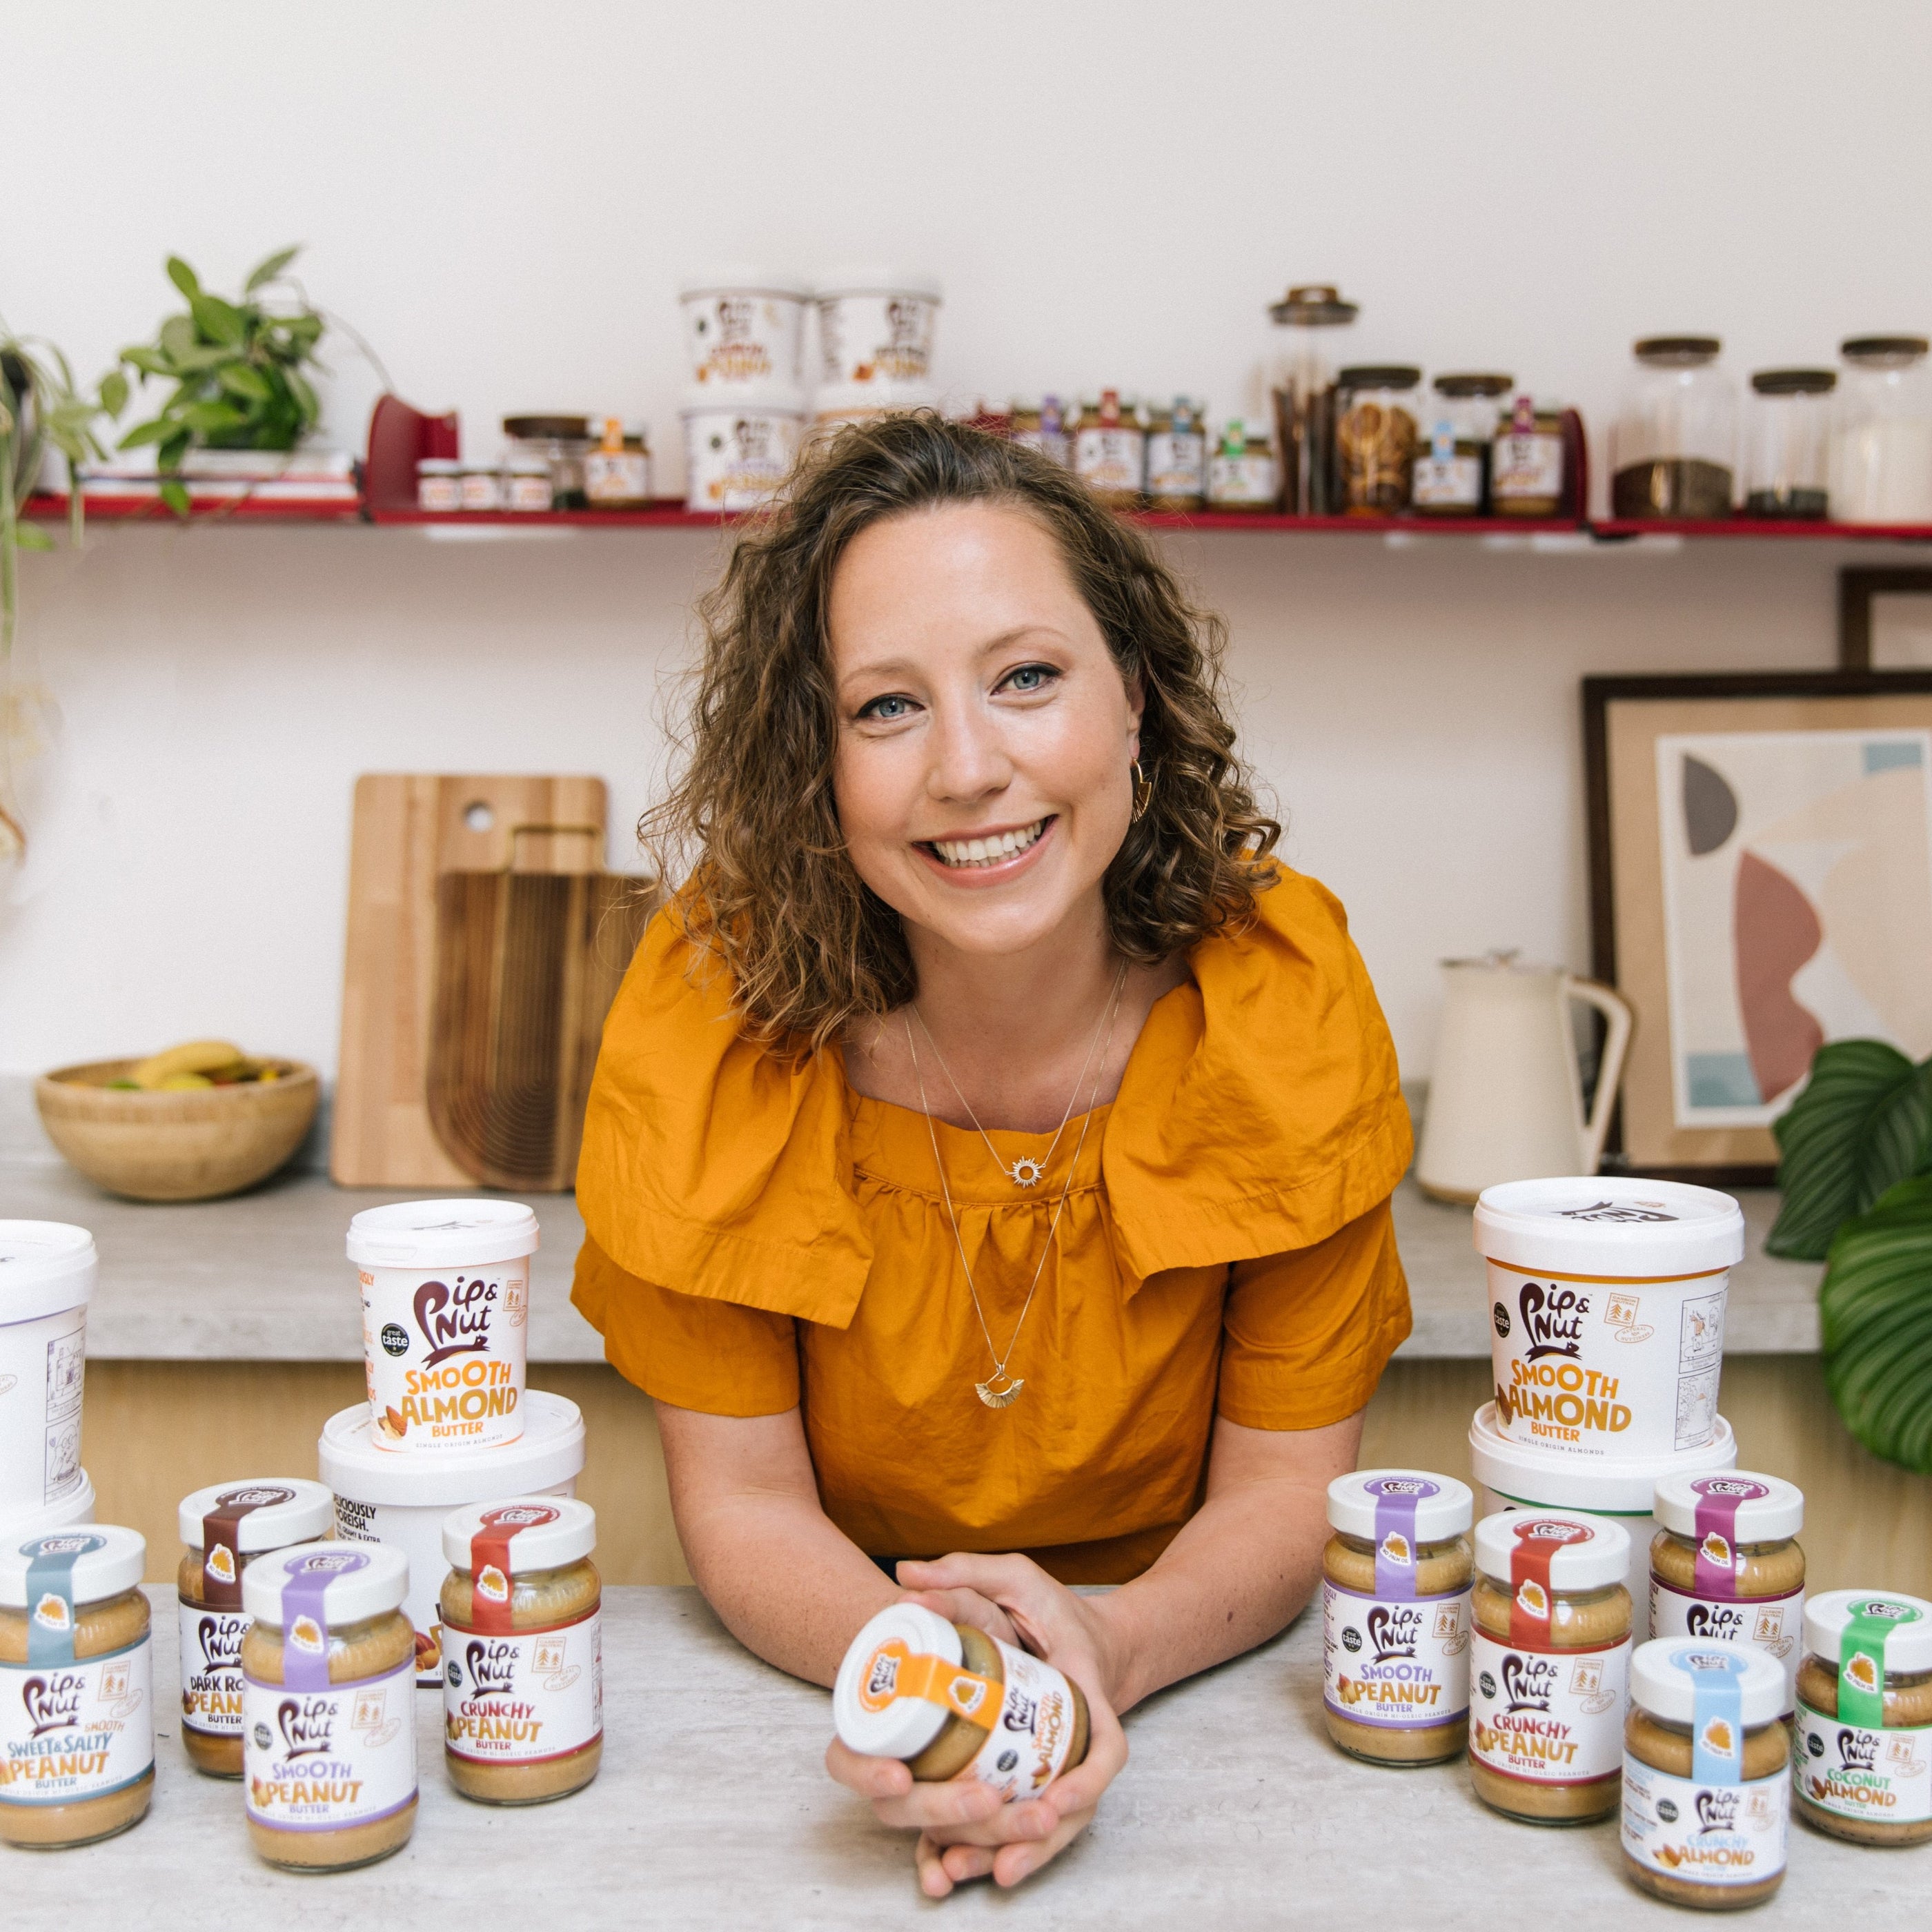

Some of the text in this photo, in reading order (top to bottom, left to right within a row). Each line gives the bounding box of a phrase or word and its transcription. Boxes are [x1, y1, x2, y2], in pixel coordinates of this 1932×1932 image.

[436, 1305, 491, 1344] Nut
[1495, 1314, 1510, 1328] taste
[1535, 1312, 1584, 1343] Nut
[382, 1334, 408, 1347] taste
[405, 1360, 511, 1395] SMOOTH
[1511, 1359, 1619, 1399] SMOOTH
[402, 1387, 518, 1426] ALMOND
[1509, 1383, 1632, 1432] ALMOND
[432, 1421, 484, 1437] BUTTER
[1530, 1421, 1580, 1442] BUTTER
[444, 1439, 471, 1448] ORIGIN
[1540, 1442, 1565, 1451] ORIGIN
[1568, 1447, 1604, 1455] ALMONDS
[1389, 1552, 1400, 1561] PALM
[1709, 1555, 1720, 1563] PALM
[1343, 1635, 1361, 1646] taste
[1346, 1630, 1357, 1638] great
[1380, 1626, 1418, 1649] Nut
[448, 1669, 463, 1681] taste
[478, 1662, 515, 1684] Nut
[1360, 1663, 1432, 1682] SMOOTH
[190, 1675, 221, 1691] DARK
[1354, 1679, 1441, 1706] PEANUT
[1480, 1680, 1496, 1692] taste
[1514, 1677, 1552, 1699] Nut
[38, 1693, 79, 1721] Nut
[190, 1691, 242, 1714] PEAN
[461, 1700, 535, 1719] CRUNCHY
[1376, 1702, 1413, 1713] BUTTER
[208, 1714, 241, 1724] BUTTER
[1032, 1693, 1052, 1750] SMOOTH
[1365, 1709, 1388, 1717] ORIGIN
[84, 1720, 125, 1733] SMOOTH
[293, 1719, 332, 1745] Nut
[455, 1716, 544, 1742] PEANUT
[1038, 1690, 1063, 1764] ALMOND
[1493, 1713, 1571, 1739] CRUNCHY
[475, 1740, 512, 1750] BUTTER
[1487, 1728, 1578, 1764] PEANUT
[1808, 1740, 1824, 1753] taste
[1846, 1745, 1876, 1761] Nut
[9, 1752, 110, 1782] PEANUT
[272, 1760, 352, 1780] SMOOTH
[1508, 1754, 1546, 1769] BUTTER
[35, 1777, 77, 1788] BUTTER
[1827, 1768, 1891, 1790] COCONUT
[266, 1780, 364, 1804] PEANUT
[1823, 1779, 1897, 1807] ALMOND
[290, 1804, 330, 1814] BUTTER
[1706, 1806, 1736, 1823] Nut
[1687, 1833, 1750, 1848] CRUNCHY
[1678, 1845, 1755, 1866] ALMOND
